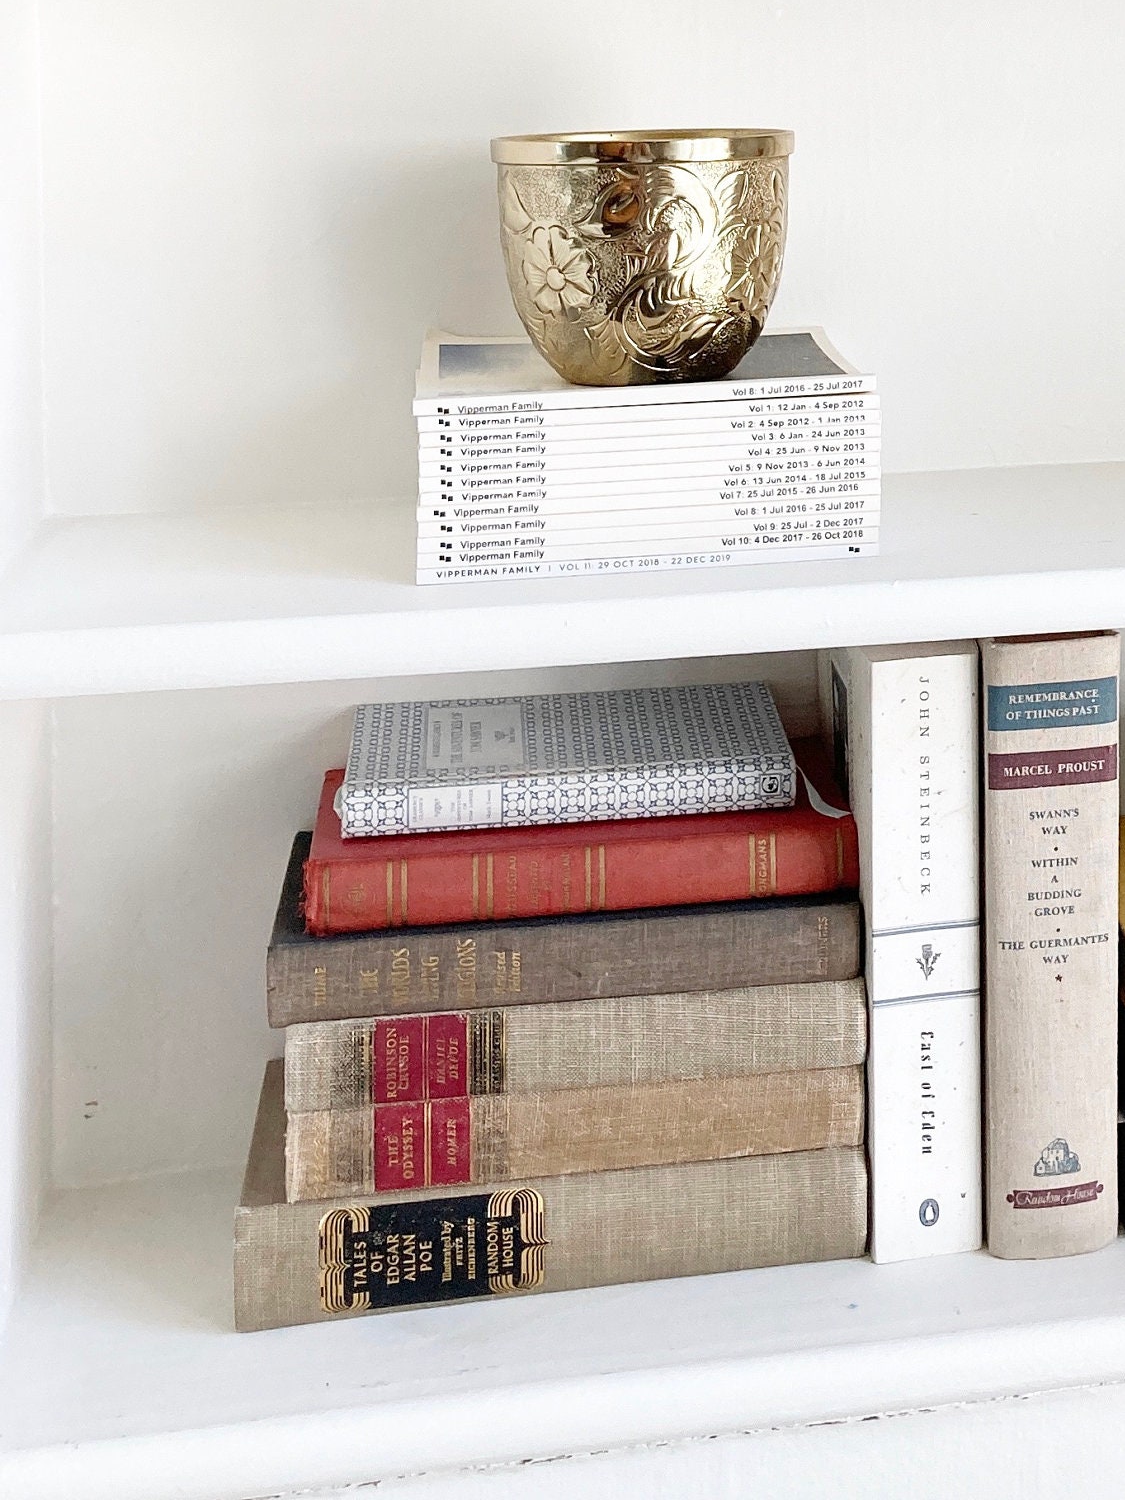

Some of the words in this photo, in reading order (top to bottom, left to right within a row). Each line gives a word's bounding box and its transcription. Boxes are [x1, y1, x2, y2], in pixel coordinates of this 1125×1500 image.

[732, 388, 746, 396] Vol
[768, 386, 782, 394] Jul
[813, 383, 824, 391] 25
[826, 381, 840, 390] Jul
[842, 380, 863, 389] 2017
[458, 404, 509, 414] Vipperman
[512, 401, 543, 410] Family
[747, 449, 763, 457] Vol
[776, 447, 787, 455] 25
[790, 446, 806, 454] Jun
[822, 445, 841, 453] Nov
[843, 443, 865, 451] 2013
[461, 463, 513, 473] Vipperman
[516, 460, 546, 469] Family
[721, 537, 736, 546] Vol
[763, 535, 780, 544] Dec
[782, 534, 803, 542] 2017
[824, 531, 841, 540] Oct
[842, 529, 864, 538] 2018
[460, 552, 511, 563] Vipperman
[513, 550, 545, 559] Family
[436, 568, 498, 578] VIPPERMAN
[502, 565, 541, 575] FAMILY
[559, 563, 580, 572] VOL
[597, 561, 610, 569] 29
[613, 560, 634, 568] OCT
[638, 558, 660, 567] 2018
[671, 557, 682, 565] 22
[686, 555, 706, 564] DEC
[710, 554, 731, 563] 2019
[1008, 688, 1100, 705] REMEMBRANCE
[919, 676, 930, 738] JOHN
[1006, 710, 1022, 720] OF
[1024, 707, 1070, 720] THINGS
[1072, 704, 1101, 717] PAST
[1004, 764, 1052, 777] MARCEL
[1058, 759, 1105, 774] PROUST
[1028, 808, 1080, 821] SWANN'S
[919, 755, 931, 895] STEINBECK
[1041, 825, 1068, 835] WAY
[1031, 856, 1079, 868] WITHIN
[1050, 875, 1059, 883] A
[1027, 888, 1082, 901] BUDDING
[1034, 905, 1075, 917] GROVE
[998, 940, 1025, 950] THE
[1029, 932, 1109, 950] GUERMANTES
[1042, 954, 1070, 964] WAY
[920, 1031, 934, 1071] East
[386, 1027, 398, 1098] ROBINSON
[921, 1082, 935, 1099] of
[447, 1118, 457, 1166] HOMER
[921, 1111, 935, 1155] Eden
[388, 1135, 399, 1167] THE
[402, 1117, 415, 1180] ODYSSEY
[419, 1240, 433, 1272] POE
[467, 1217, 476, 1280] EICHENBERG
[486, 1221, 499, 1275] RANDOM
[502, 1226, 514, 1268] HOUSE
[353, 1241, 368, 1287] TALES
[370, 1253, 384, 1273] OF
[386, 1233, 400, 1285] EDGAR
[403, 1234, 417, 1282] ALLAN
